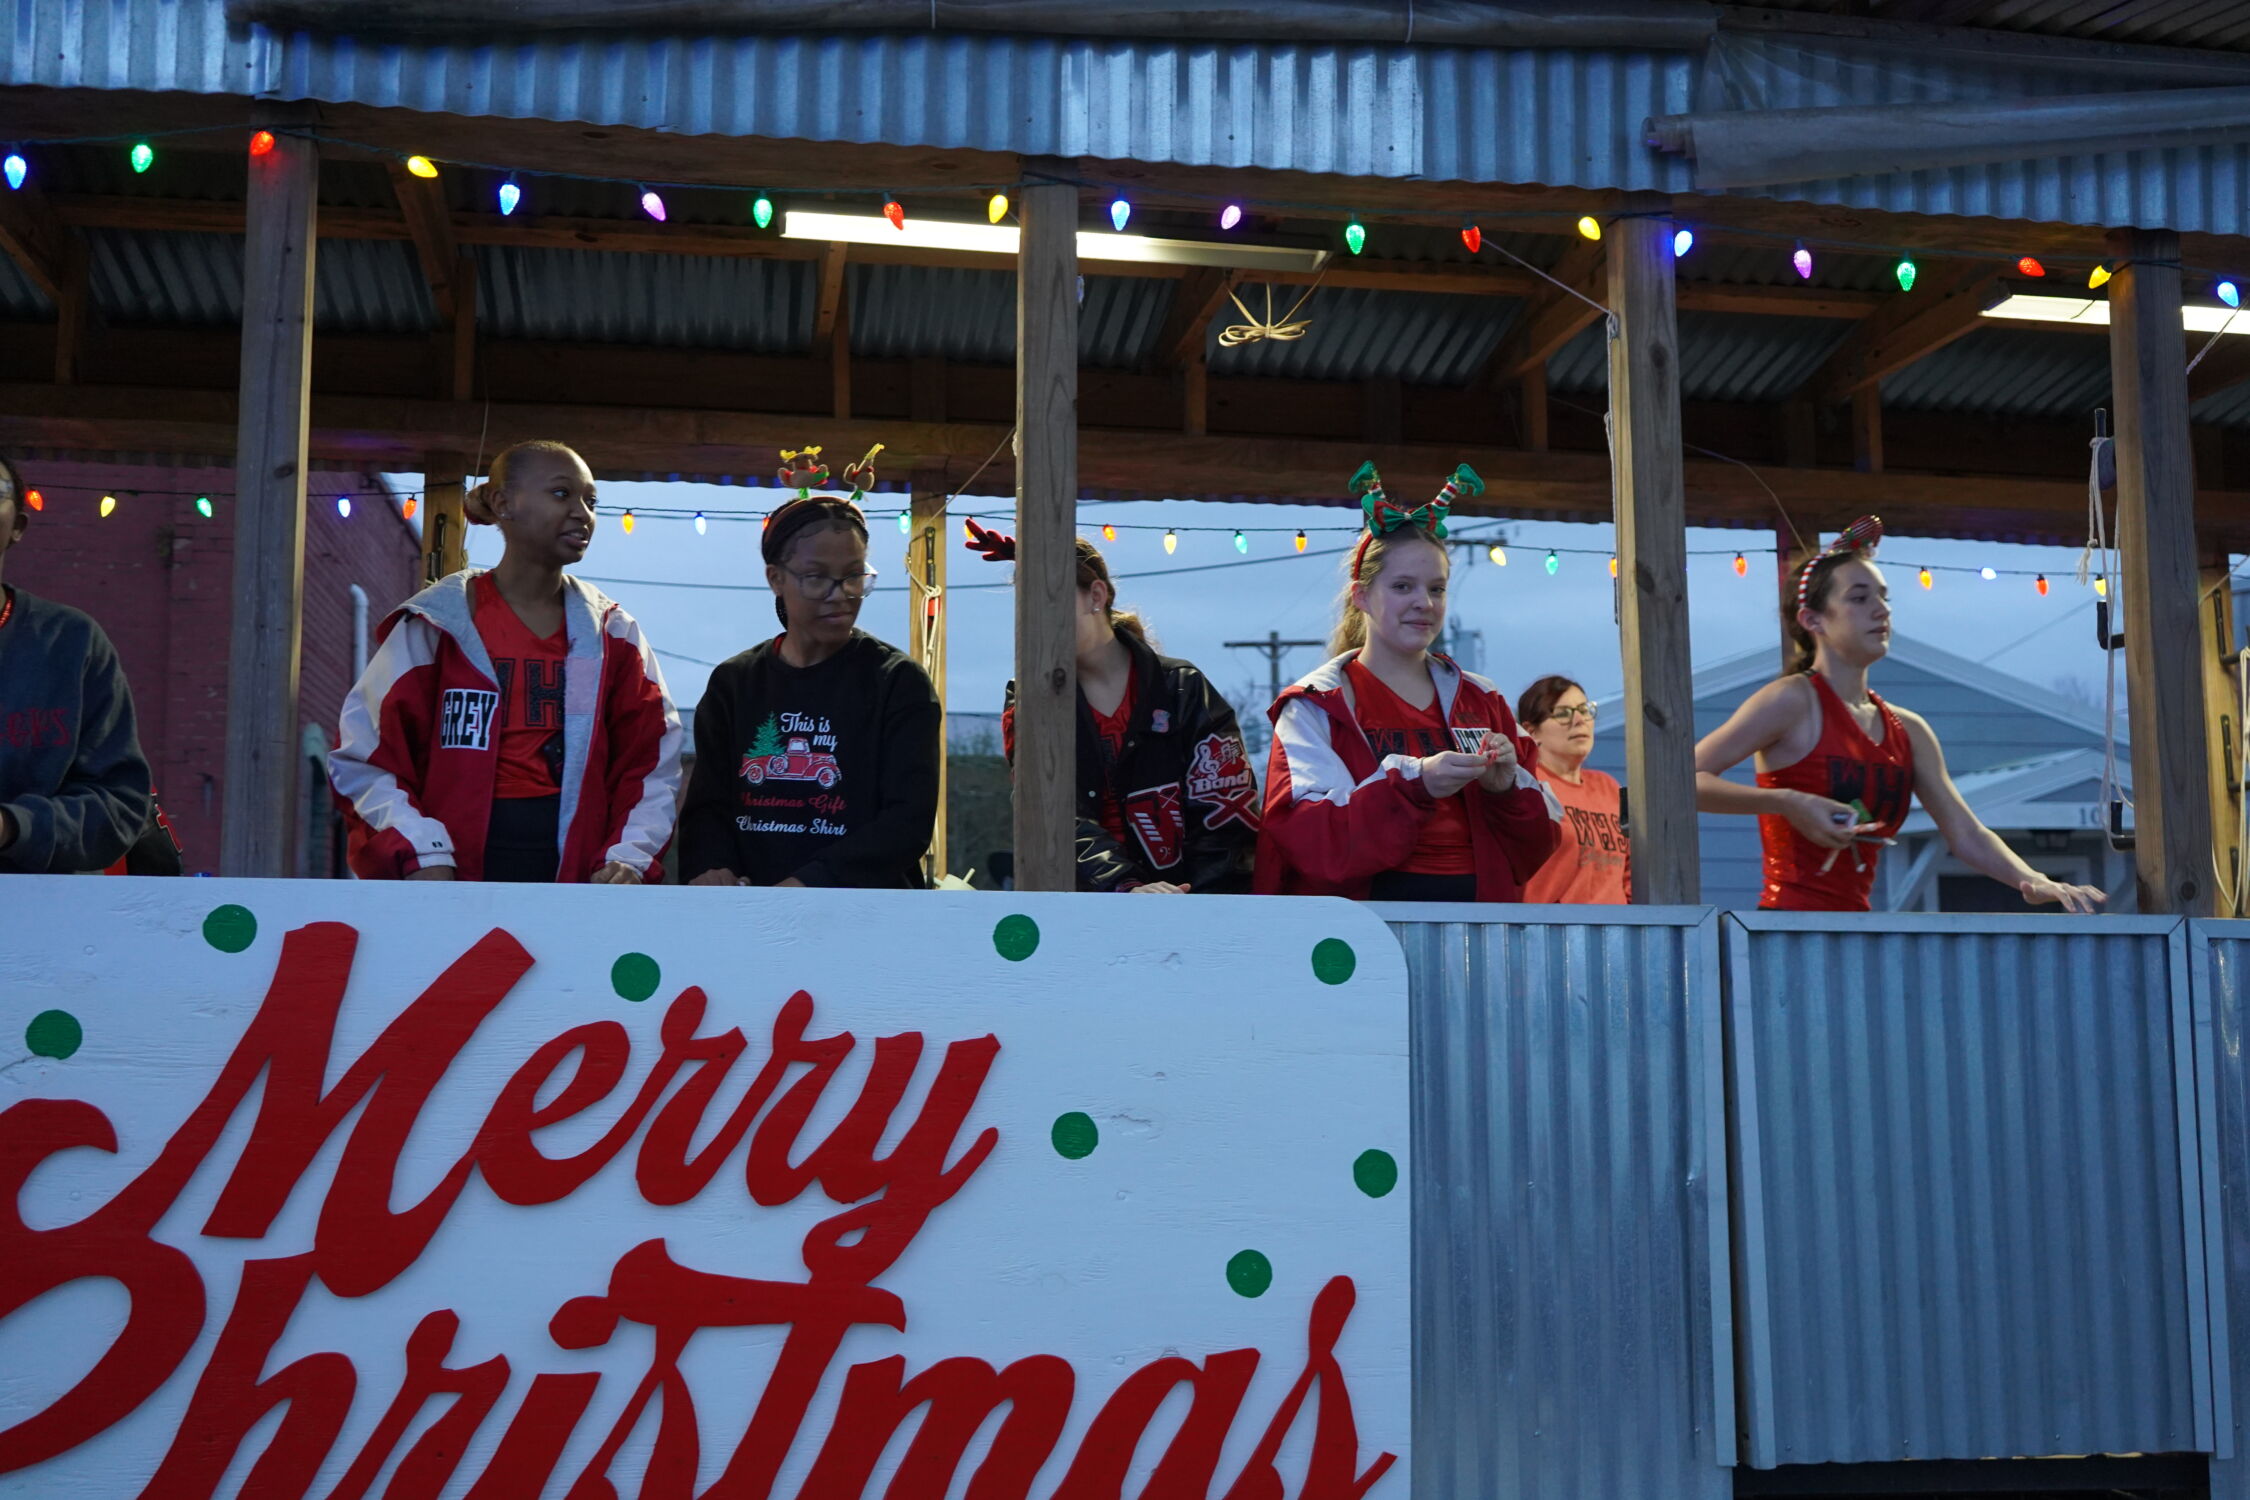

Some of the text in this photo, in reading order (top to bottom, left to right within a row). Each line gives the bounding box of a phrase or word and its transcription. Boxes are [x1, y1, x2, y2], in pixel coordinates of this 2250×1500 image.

[441, 689, 498, 750] GREY
[780, 711, 831, 733] This is
[812, 733, 838, 752] my
[1191, 770, 1250, 794] Band
[808, 793, 847, 815] Gift
[735, 815, 848, 836] Christmas Shirt
[0, 921, 1000, 1297] Merry
